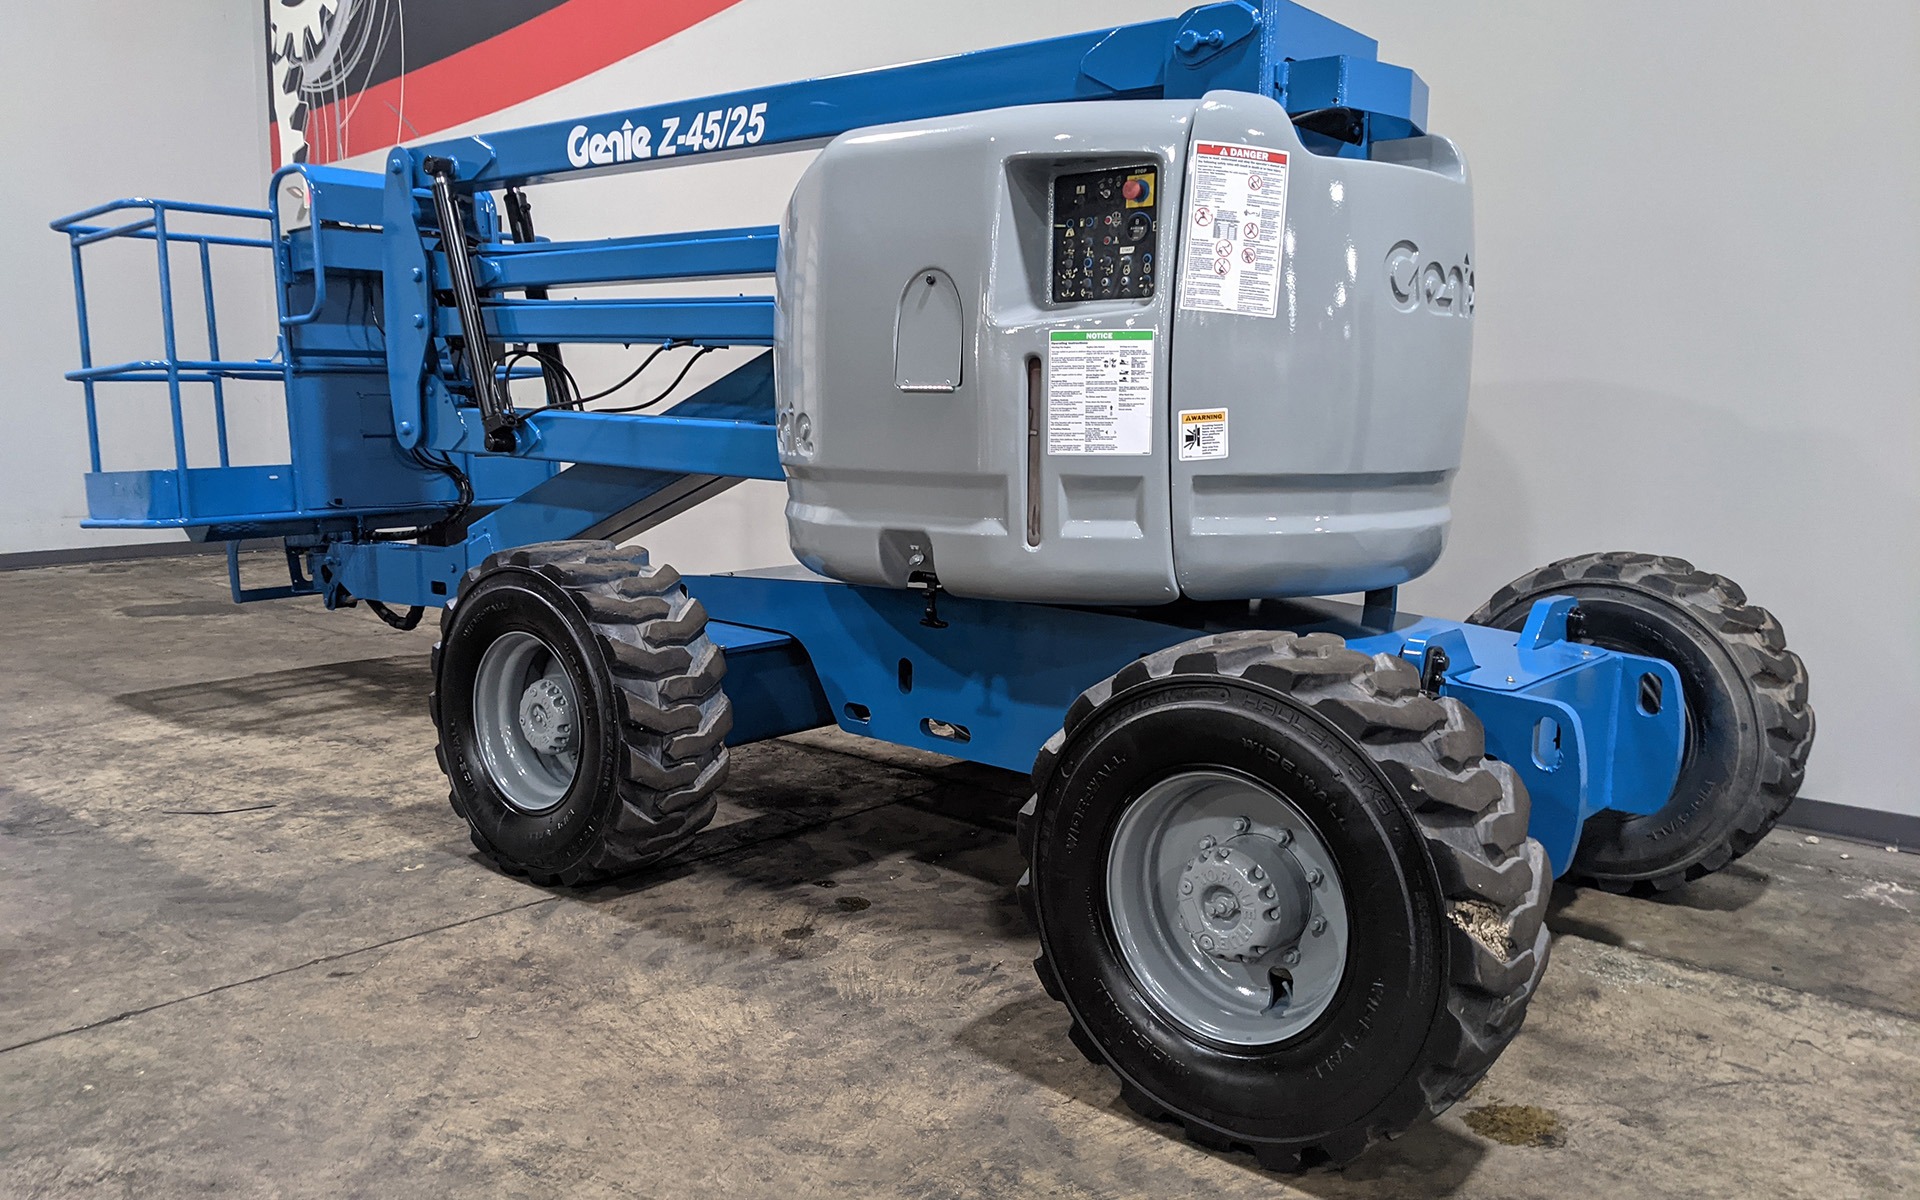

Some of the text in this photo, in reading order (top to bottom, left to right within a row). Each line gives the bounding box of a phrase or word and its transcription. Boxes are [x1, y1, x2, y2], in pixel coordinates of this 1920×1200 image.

[567, 102, 768, 167] Genie Z-45/25
[1229, 148, 1269, 160] DANGER
[1086, 332, 1113, 340] NOTICE
